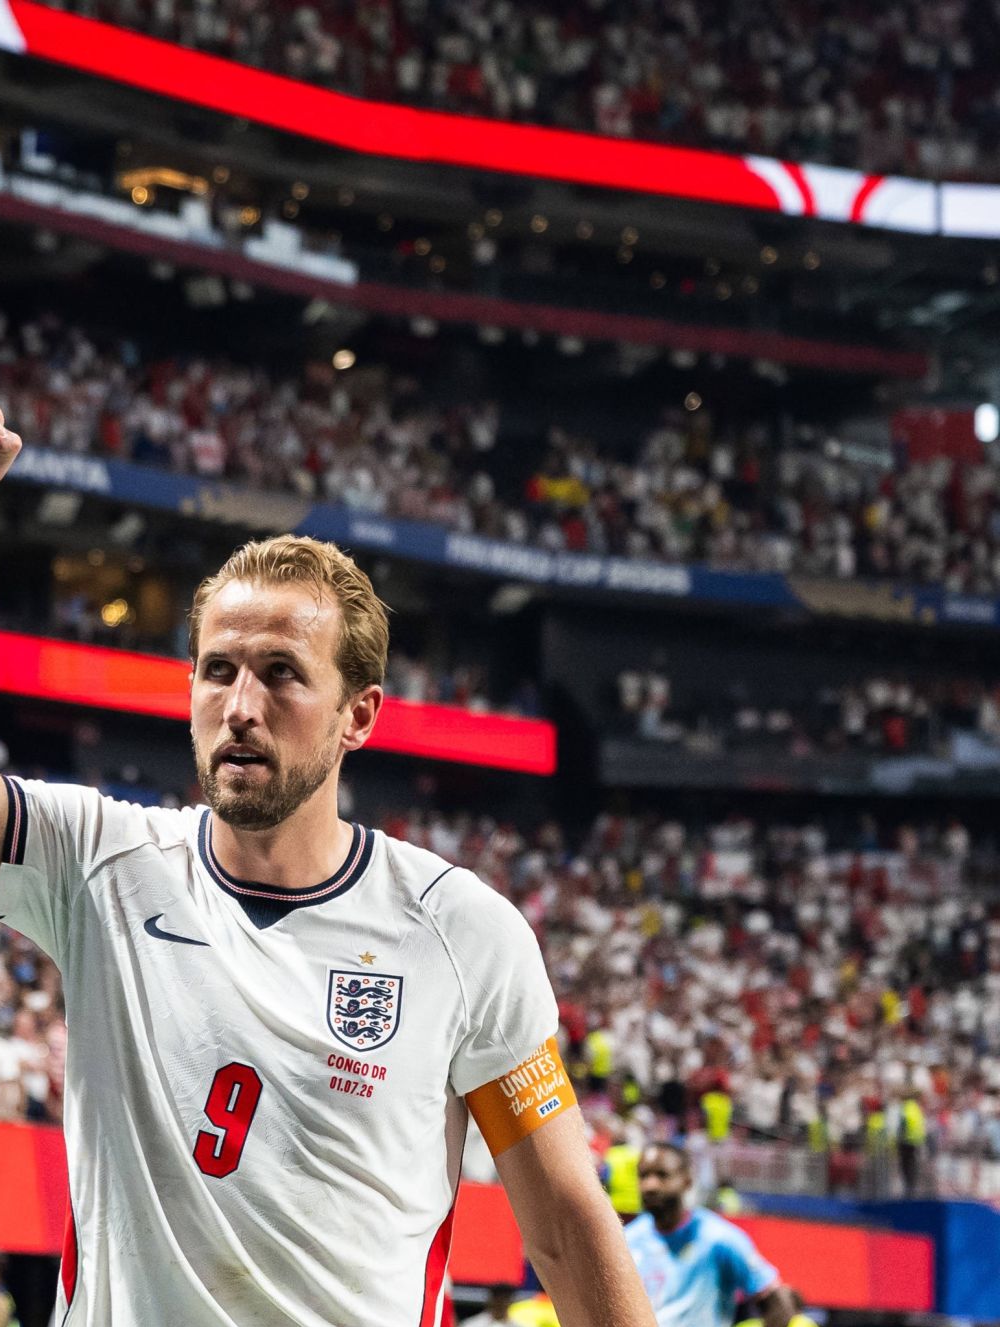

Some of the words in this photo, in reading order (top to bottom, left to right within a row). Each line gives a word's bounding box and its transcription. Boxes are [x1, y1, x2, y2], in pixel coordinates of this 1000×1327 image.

[328, 1054, 369, 1077] CONGO
[372, 1065, 387, 1081] DR
[500, 1053, 556, 1098] UNITES
[329, 1076, 374, 1098] 01.07.26
[509, 1097, 534, 1116] the
[532, 1071, 566, 1101] World
[192, 1061, 263, 1179] 9
[540, 1099, 560, 1115] FIFA
